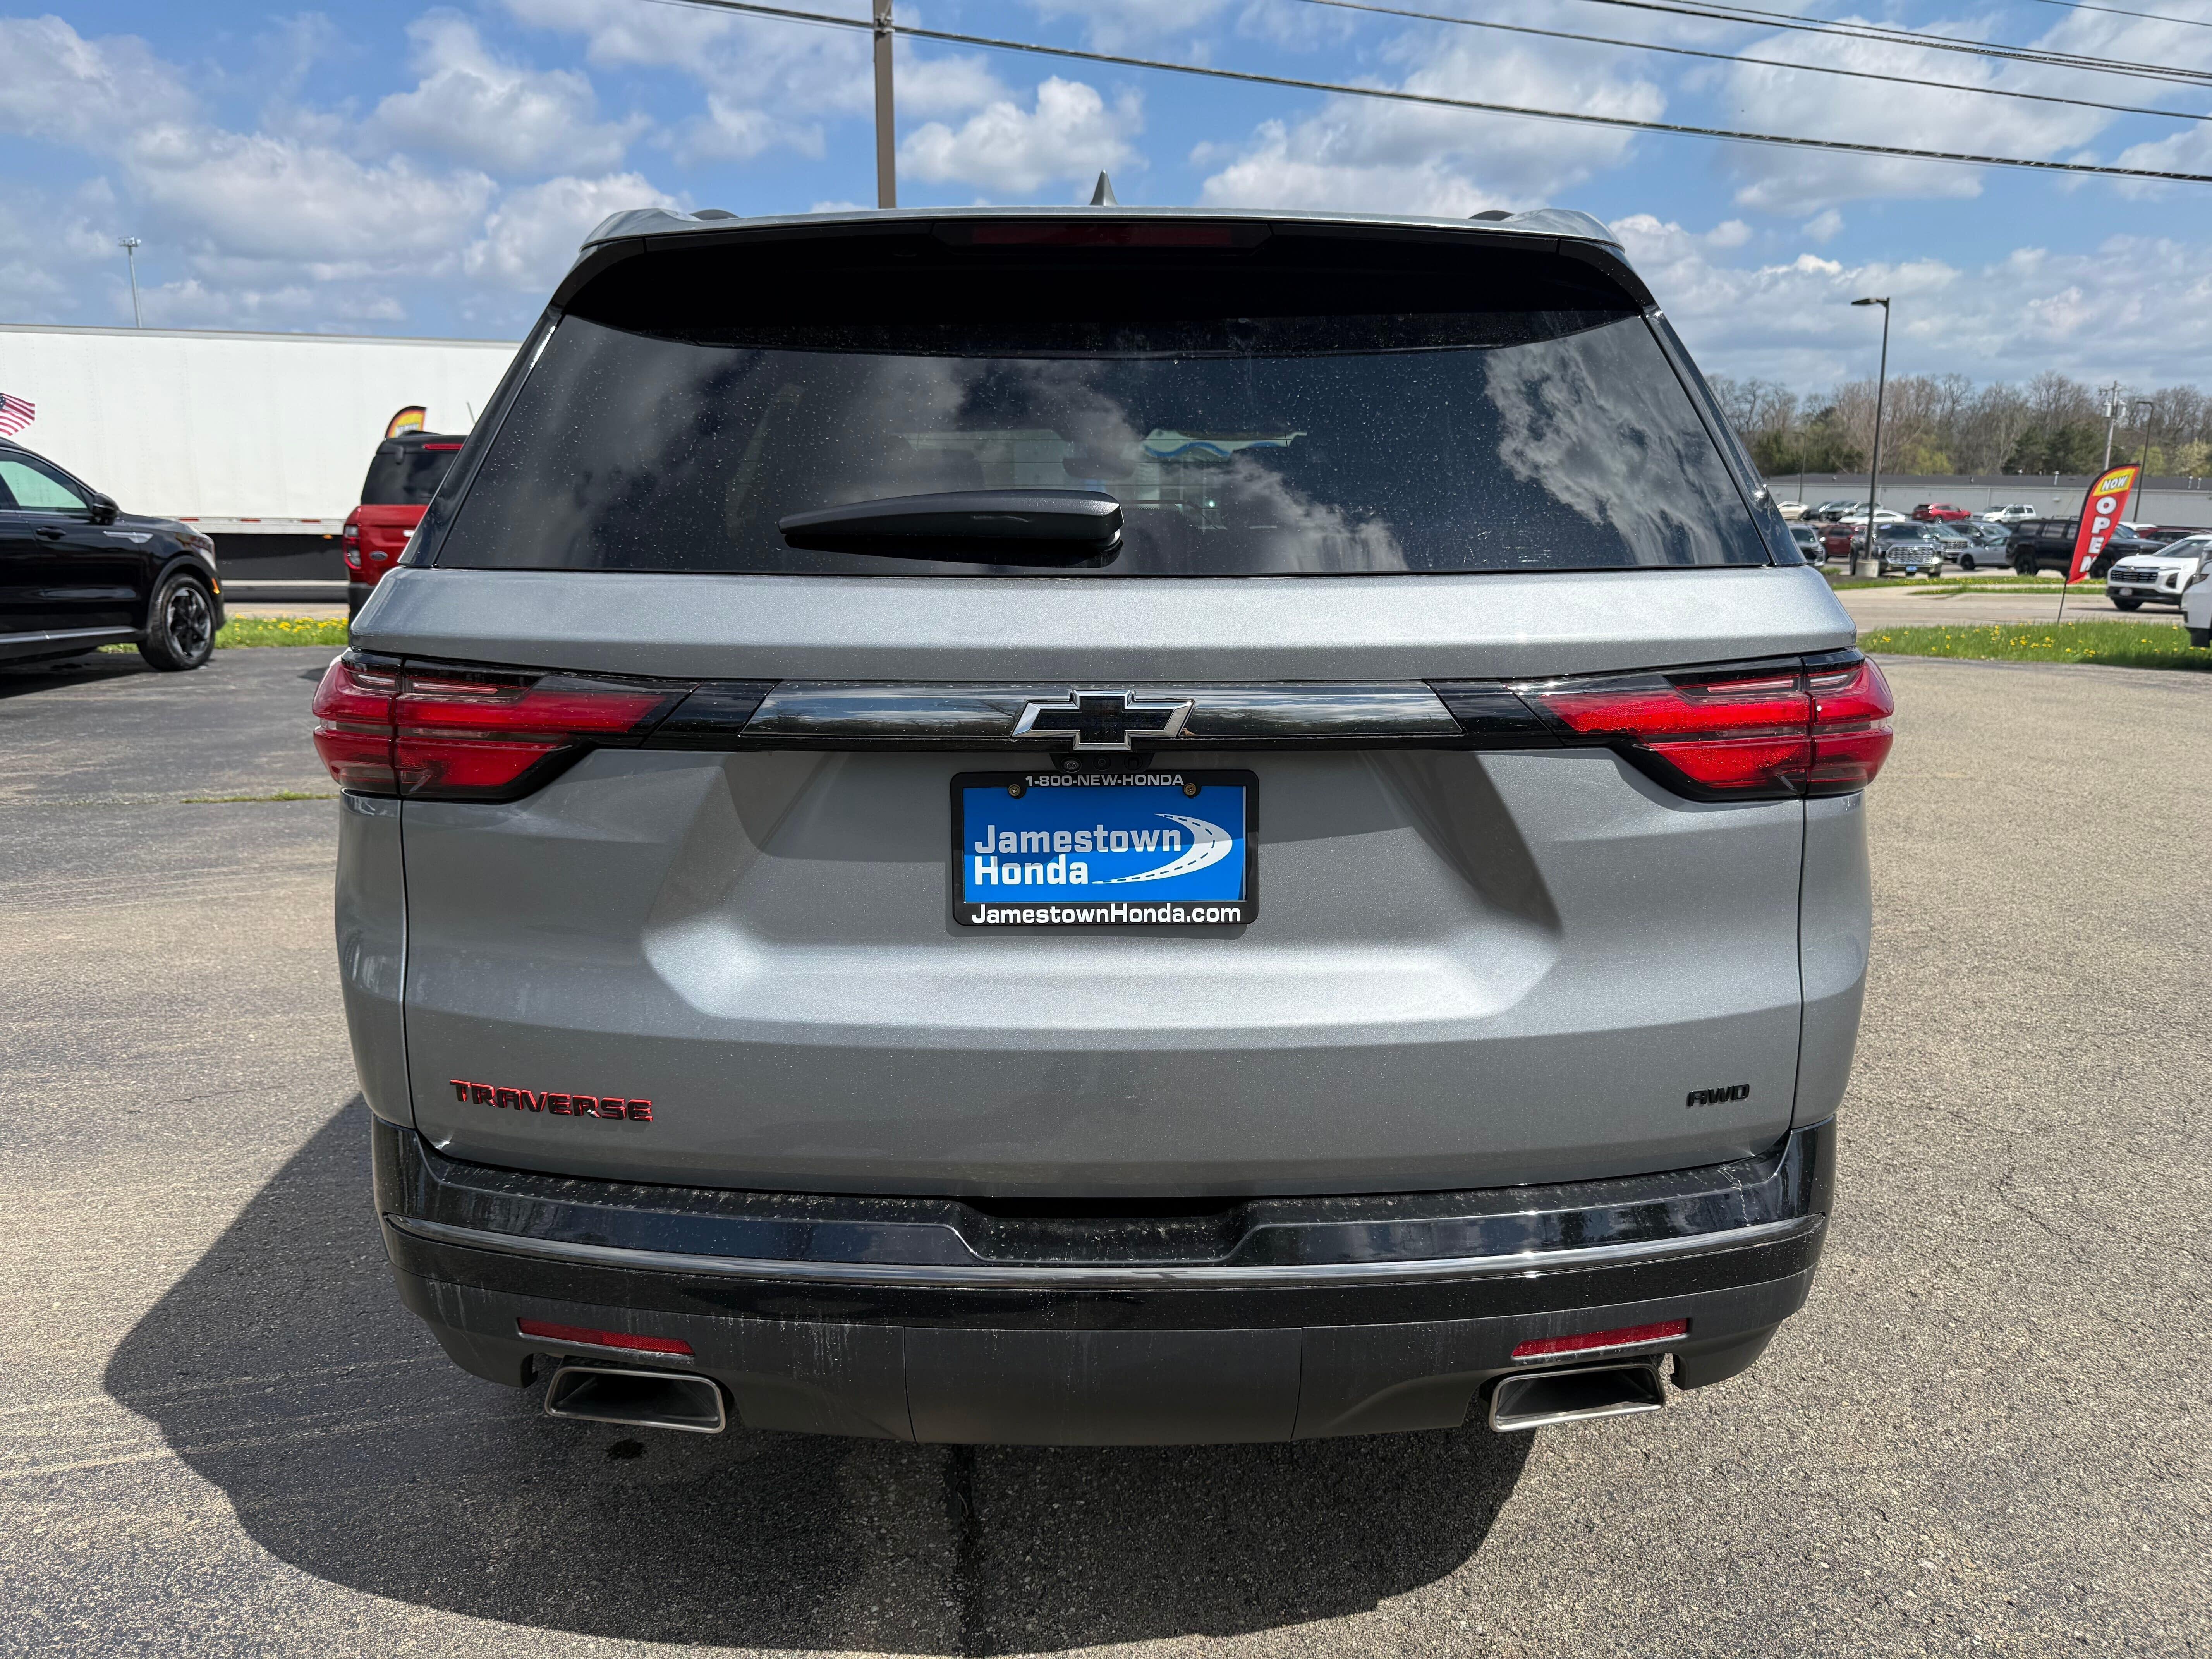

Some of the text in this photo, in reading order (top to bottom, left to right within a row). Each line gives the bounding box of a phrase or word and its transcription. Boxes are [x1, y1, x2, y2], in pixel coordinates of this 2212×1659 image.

[2102, 476, 2128, 491] NOW
[1025, 774, 1184, 786] 1-800-NEW-HONDA
[975, 824, 1181, 853] Jamestown
[975, 854, 1088, 885] Honda
[972, 903, 1241, 924] JamestownHonda.com
[450, 1079, 654, 1122] TRAVERSE
[1686, 1084, 1750, 1107] AWD
